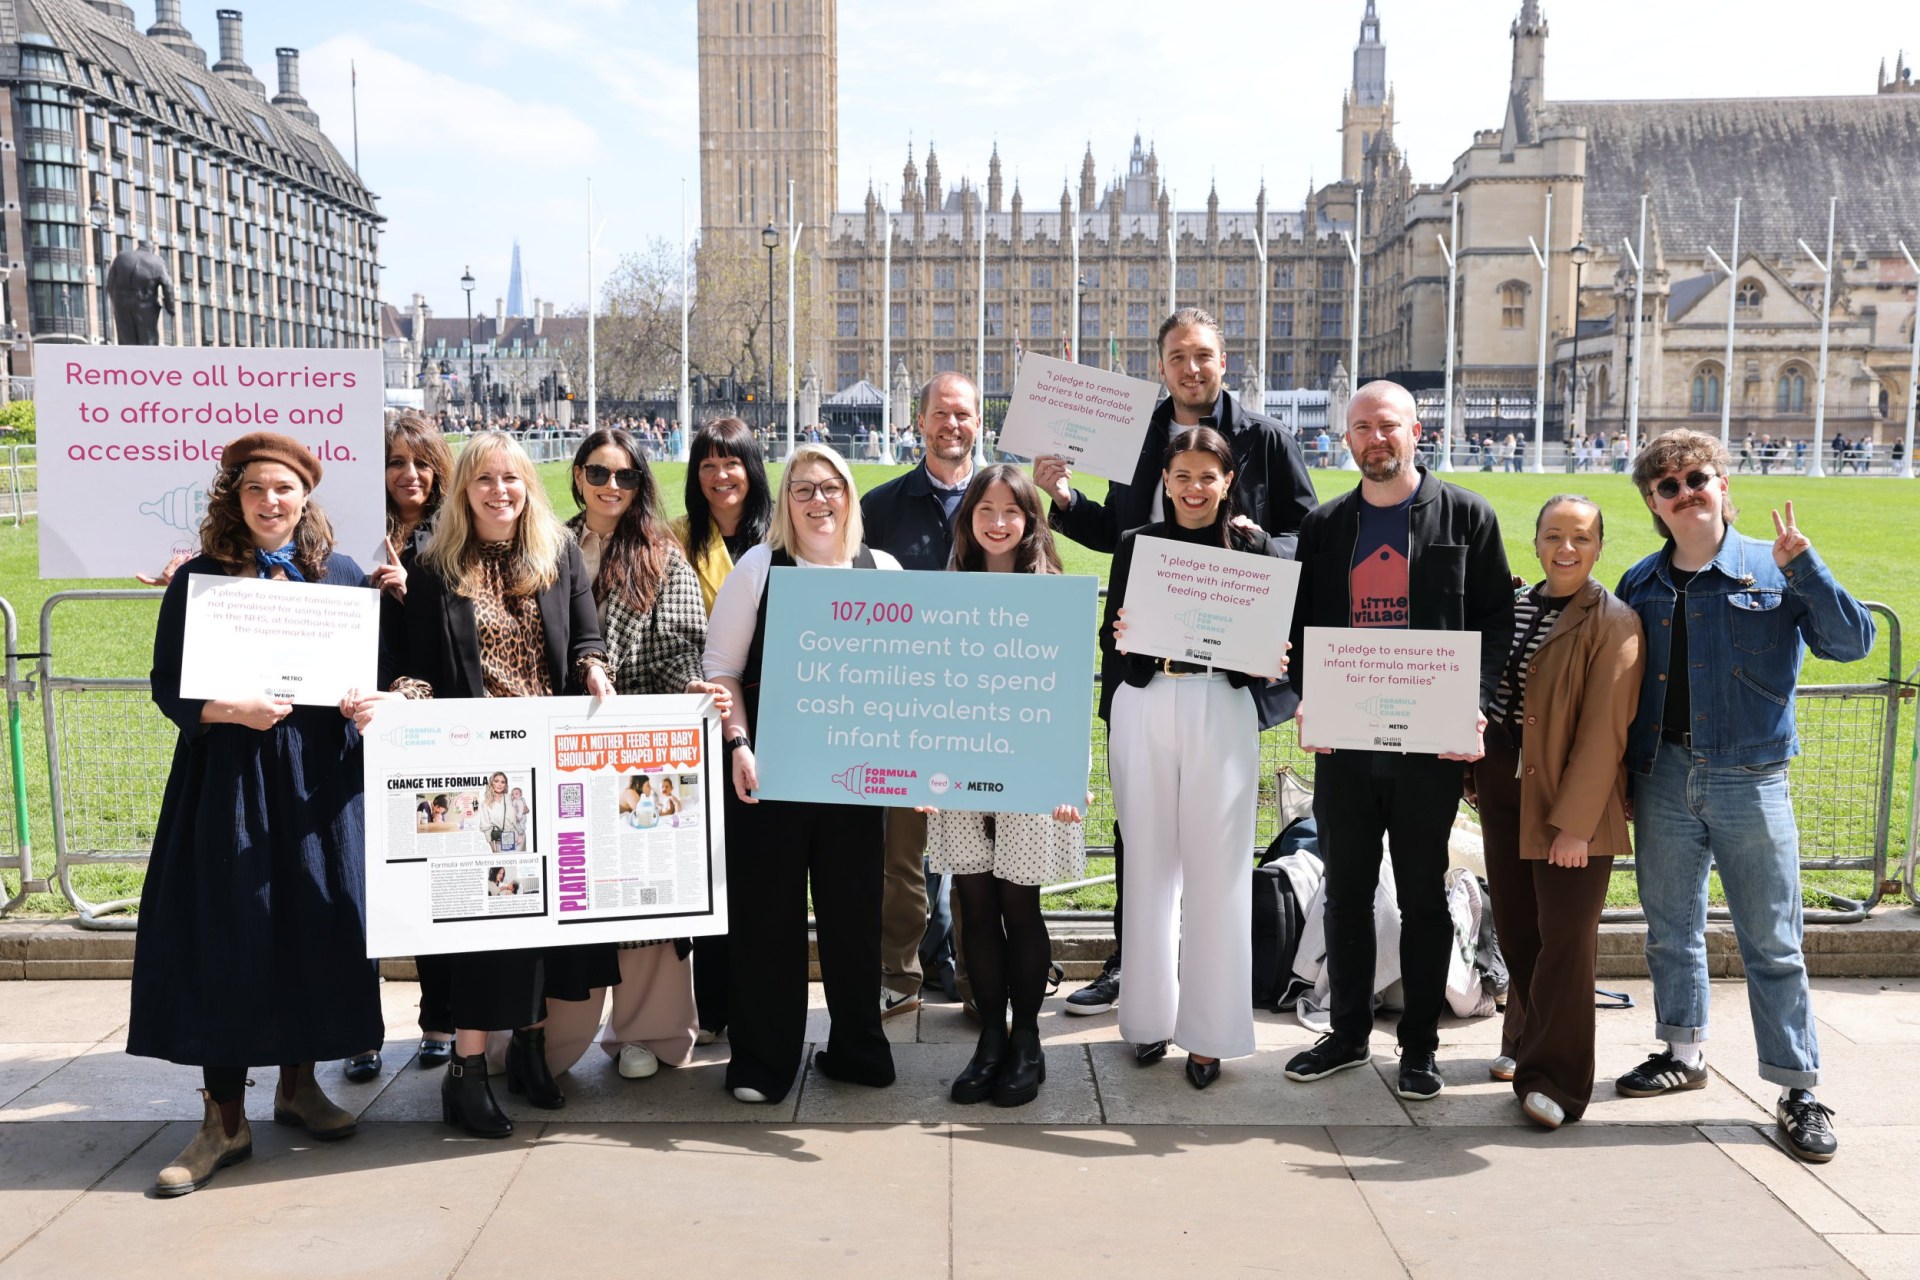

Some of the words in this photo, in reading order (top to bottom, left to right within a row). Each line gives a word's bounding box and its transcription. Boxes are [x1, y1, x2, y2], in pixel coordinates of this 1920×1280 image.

[66, 362, 182, 386] Remove
[192, 365, 228, 386] all
[238, 366, 356, 388] barriers
[1053, 373, 1084, 387] pledge
[1086, 381, 1095, 390] to
[1097, 385, 1130, 399] remove
[1029, 392, 1046, 403] and
[1048, 398, 1094, 415] accessible
[1037, 380, 1072, 396] barriers
[1074, 390, 1084, 400] to
[1086, 394, 1133, 412] affordable
[79, 402, 109, 423] to
[120, 402, 279, 425] affordable
[288, 403, 343, 425] and
[1067, 422, 1097, 434] FORMULA
[67, 440, 224, 462] accessible
[1068, 445, 1084, 453] METRO
[172, 547, 193, 555] feed
[1169, 555, 1206, 571] pledge
[1209, 563, 1220, 572] to
[1222, 566, 1271, 581] empower
[1157, 569, 1194, 583] women
[1196, 575, 1218, 586] with
[1220, 579, 1270, 595] informed
[219, 589, 254, 600] pledge
[255, 592, 266, 600] to
[268, 594, 302, 603] ensure
[304, 595, 342, 607] families
[343, 599, 360, 607] are
[1167, 584, 1207, 601] feeding
[207, 600, 225, 608] not
[227, 601, 276, 612] penalised
[278, 604, 292, 613] for
[295, 607, 321, 617] using
[324, 608, 361, 619] formula
[831, 601, 914, 626] 107,000
[920, 606, 981, 627] want
[988, 607, 1030, 628] the
[213, 612, 223, 620] in
[225, 612, 242, 621] the
[272, 616, 282, 625] at
[284, 616, 336, 629] foodbanks
[351, 622, 361, 630] at
[1197, 617, 1212, 625] FOR
[1198, 611, 1233, 624] FORMULA
[234, 625, 252, 634] the
[254, 626, 316, 639] supermarket
[1196, 624, 1226, 634] CHANGE
[799, 630, 951, 656] Government
[960, 637, 985, 658] to
[993, 638, 1059, 660] allow
[1202, 638, 1222, 646] METRO
[1338, 645, 1376, 657] pledge
[1379, 646, 1390, 655] to
[1394, 648, 1433, 656] ensure
[1436, 647, 1456, 657] the
[1323, 658, 1356, 668] infant
[1359, 659, 1403, 670] formula
[1407, 662, 1447, 672] market
[1450, 662, 1460, 672] is
[281, 674, 303, 682] METRO
[796, 662, 833, 683] UK
[838, 664, 936, 687] families
[943, 668, 969, 689] to
[976, 671, 1056, 694] spend
[1346, 673, 1365, 683] fair
[1368, 674, 1385, 684] for
[796, 694, 855, 715] cash
[863, 697, 1011, 723] equivalents
[1019, 707, 1052, 724] on
[404, 727, 442, 735] FORMULA
[451, 732, 469, 740] feed
[490, 729, 527, 740] METRO
[558, 736, 578, 751] HOW
[581, 736, 588, 750] A
[590, 734, 624, 750] MOTHER
[626, 733, 650, 748] FEEDS
[653, 732, 668, 747] HER
[671, 731, 694, 746] BABY
[827, 725, 901, 749] infant
[908, 729, 1015, 754] formula.
[607, 750, 618, 764] BE
[621, 748, 653, 764] SHAPED
[656, 748, 667, 762] BY
[670, 747, 698, 761] MONEY
[865, 768, 918, 779] FORMULA
[865, 776, 886, 785] FOR
[387, 778, 424, 790] CHANGE
[425, 777, 444, 788] THE
[444, 776, 488, 788] FORMULA
[931, 779, 948, 788] feed
[967, 781, 1004, 793] METRO
[864, 786, 908, 796] CHANGE
[431, 861, 458, 869] Formula
[558, 832, 587, 912] PLATFORM
